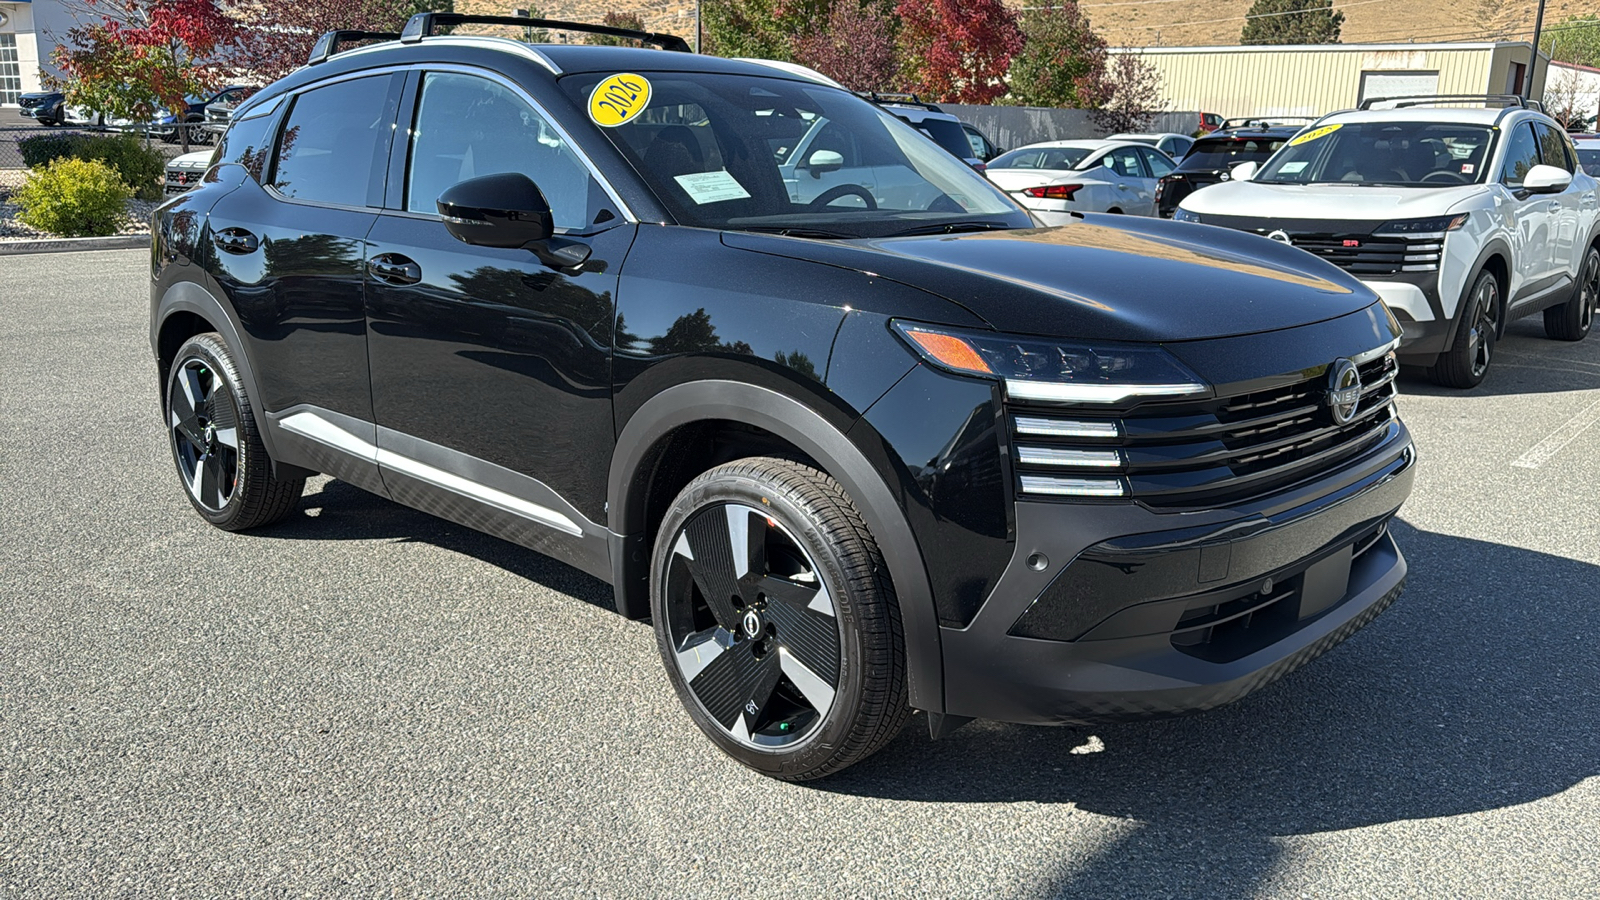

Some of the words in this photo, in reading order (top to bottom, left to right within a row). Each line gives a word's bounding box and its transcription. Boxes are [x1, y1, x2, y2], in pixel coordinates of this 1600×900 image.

[598, 77, 642, 118] 2026
[1343, 239, 1359, 247] SR
[1332, 390, 1359, 403] NISS
[804, 527, 855, 623] BRIDGESTONE
